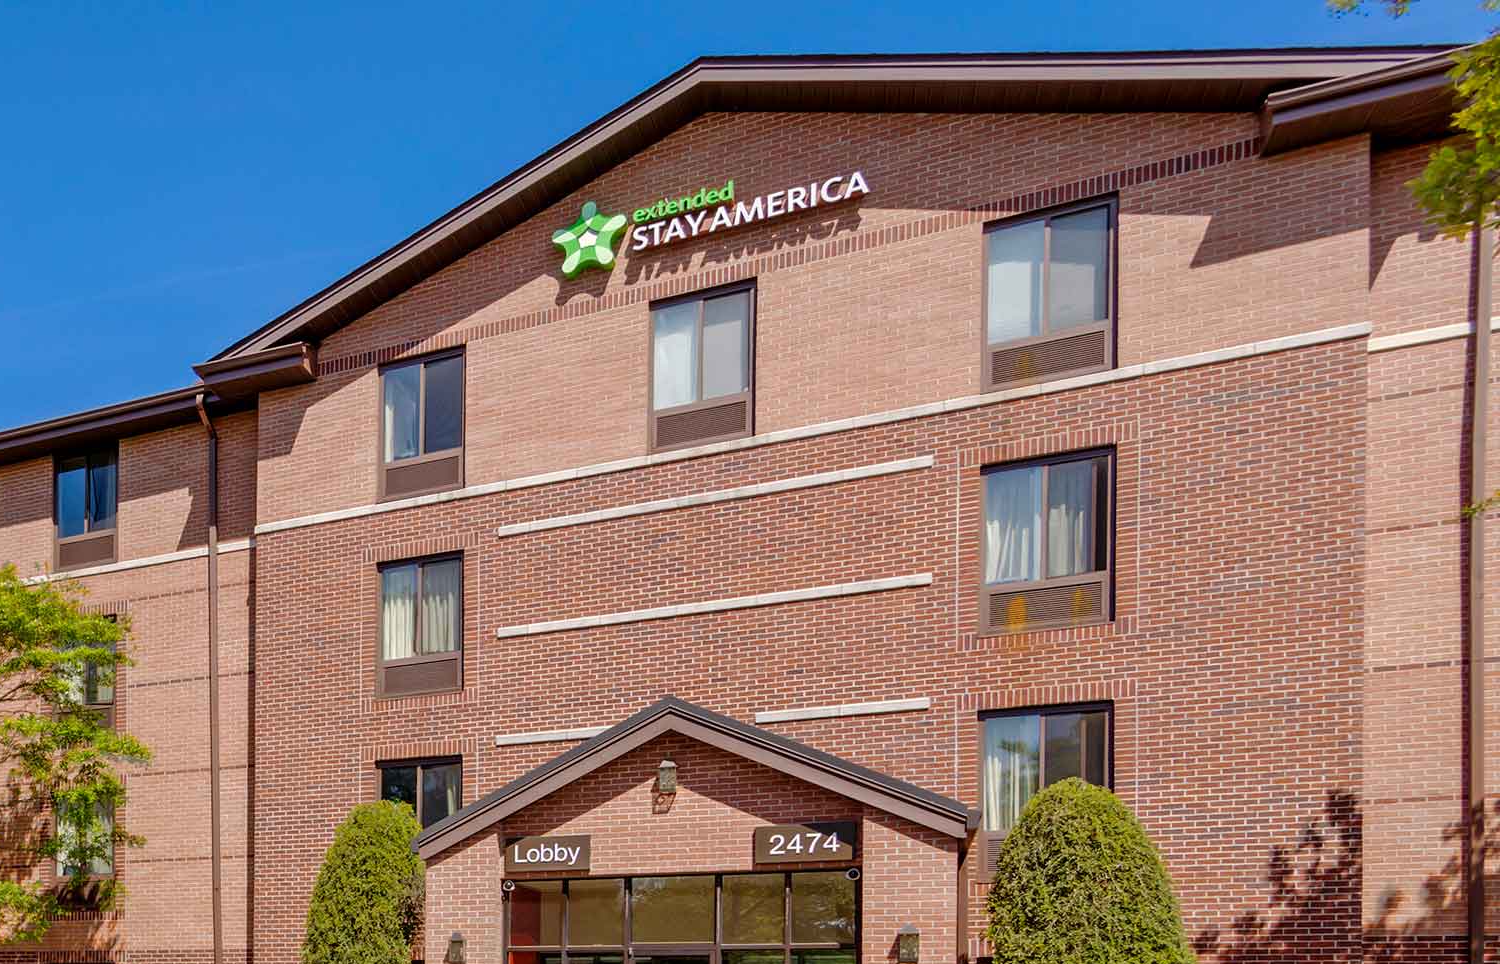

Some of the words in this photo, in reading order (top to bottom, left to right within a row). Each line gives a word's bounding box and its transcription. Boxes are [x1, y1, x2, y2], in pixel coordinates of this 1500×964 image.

[632, 179, 734, 223] extended
[632, 210, 707, 250] STAY
[709, 171, 870, 232] AMERICA
[513, 845, 581, 866] Lobby
[768, 833, 841, 855] 2474
